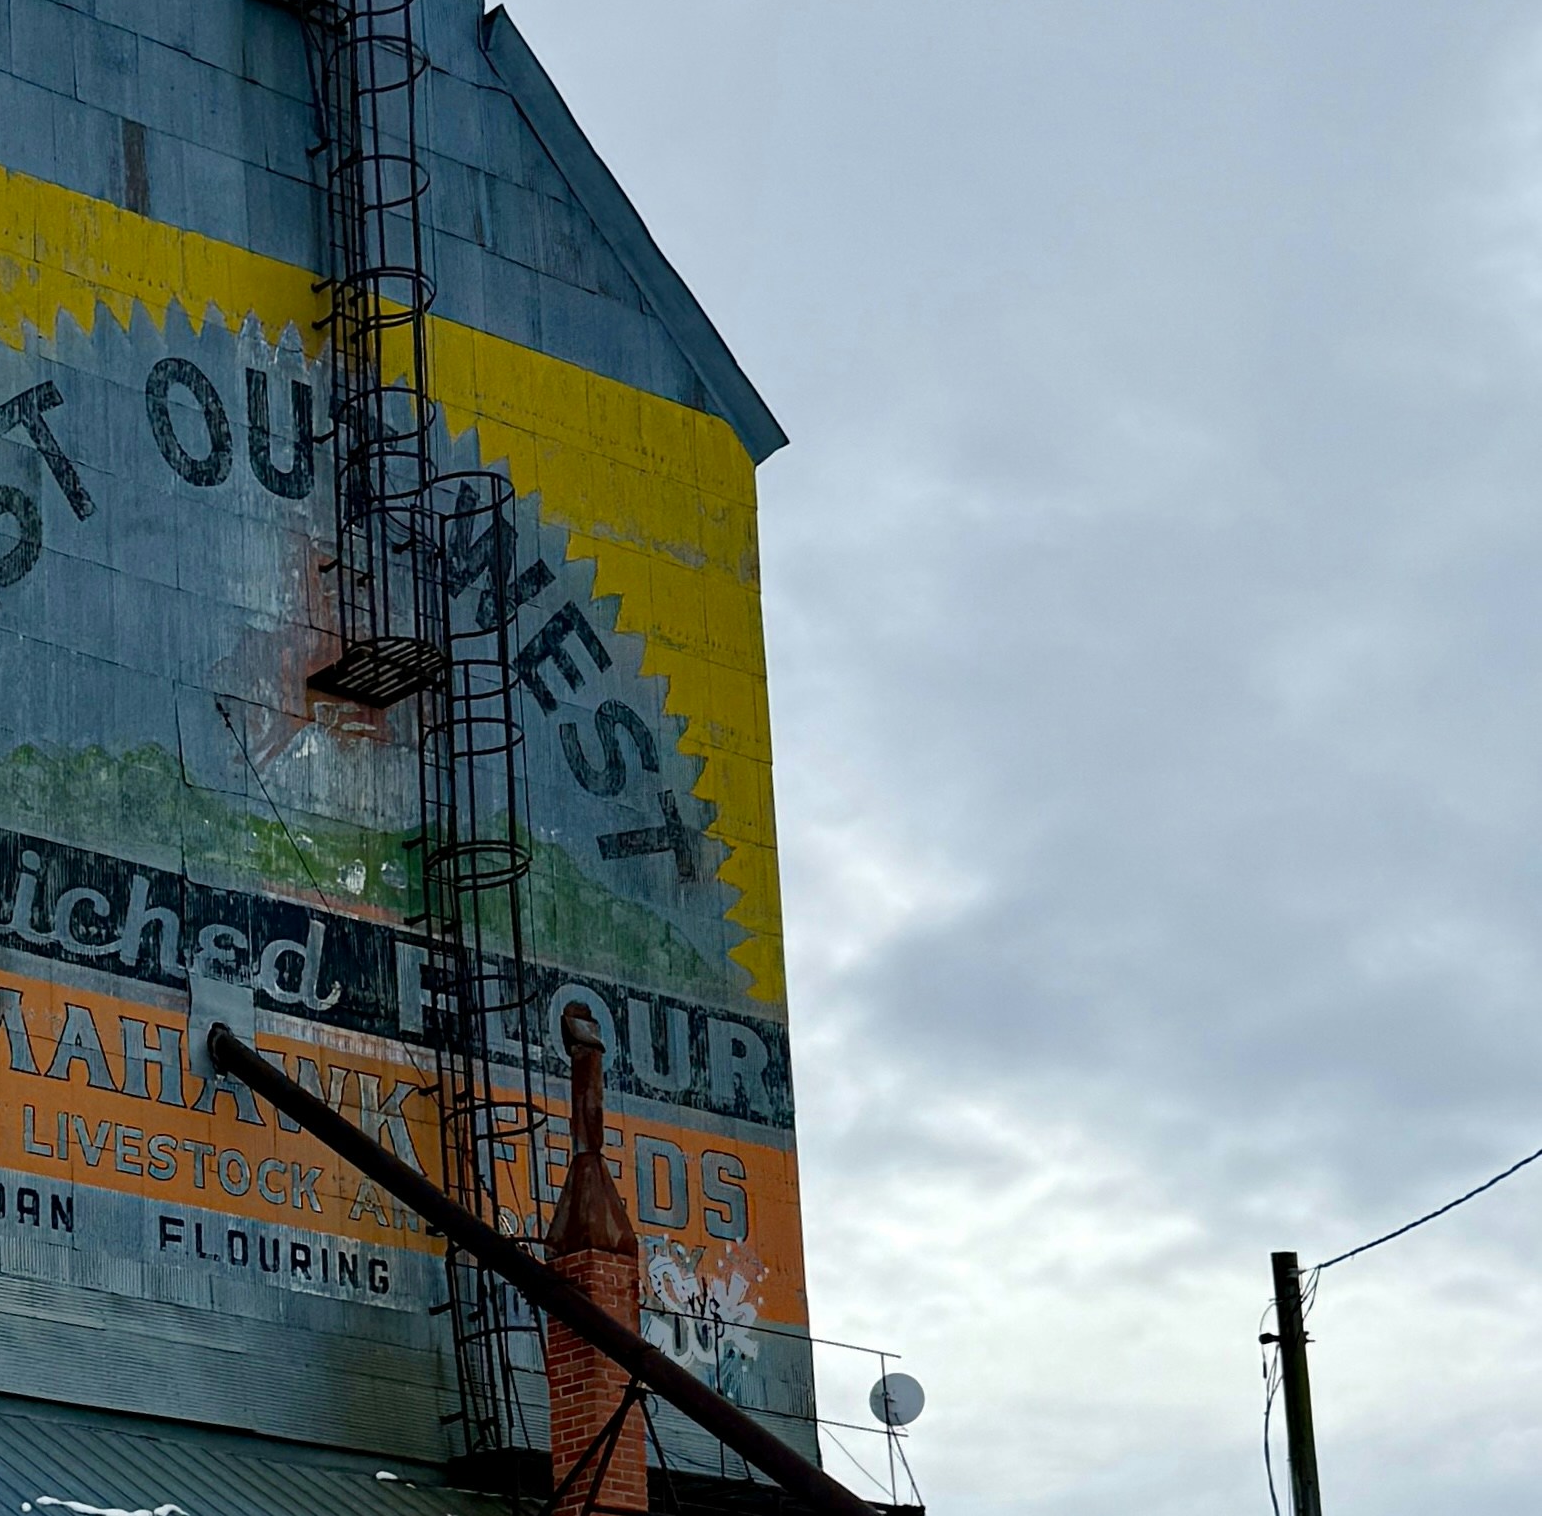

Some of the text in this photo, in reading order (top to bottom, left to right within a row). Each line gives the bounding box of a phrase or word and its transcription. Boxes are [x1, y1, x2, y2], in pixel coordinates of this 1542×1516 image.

[443, 480, 692, 877] WEST
[395, 941, 772, 1117] FLOUR
[23, 1104, 325, 1213] LIVESTOCK
[158, 1214, 390, 1295] FLOURING
